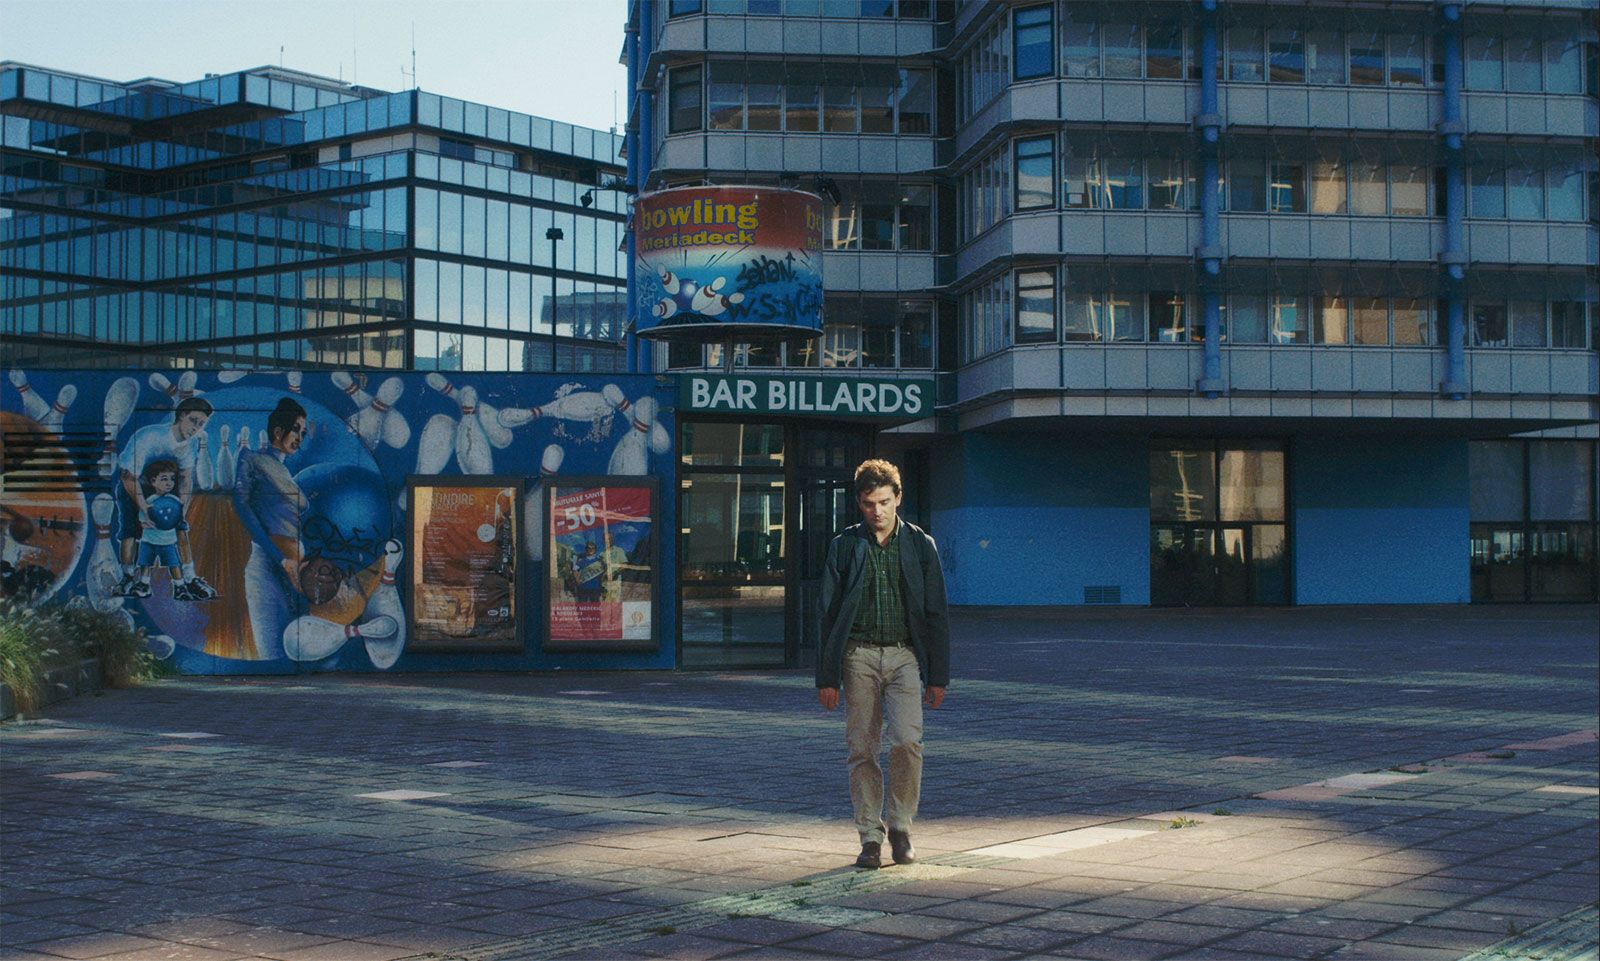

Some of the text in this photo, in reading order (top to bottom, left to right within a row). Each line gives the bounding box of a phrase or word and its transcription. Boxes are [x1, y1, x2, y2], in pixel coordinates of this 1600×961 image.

[641, 198, 758, 231] bowling
[642, 230, 755, 250] Meriadeck
[692, 378, 922, 414] BAR BILLARDS
